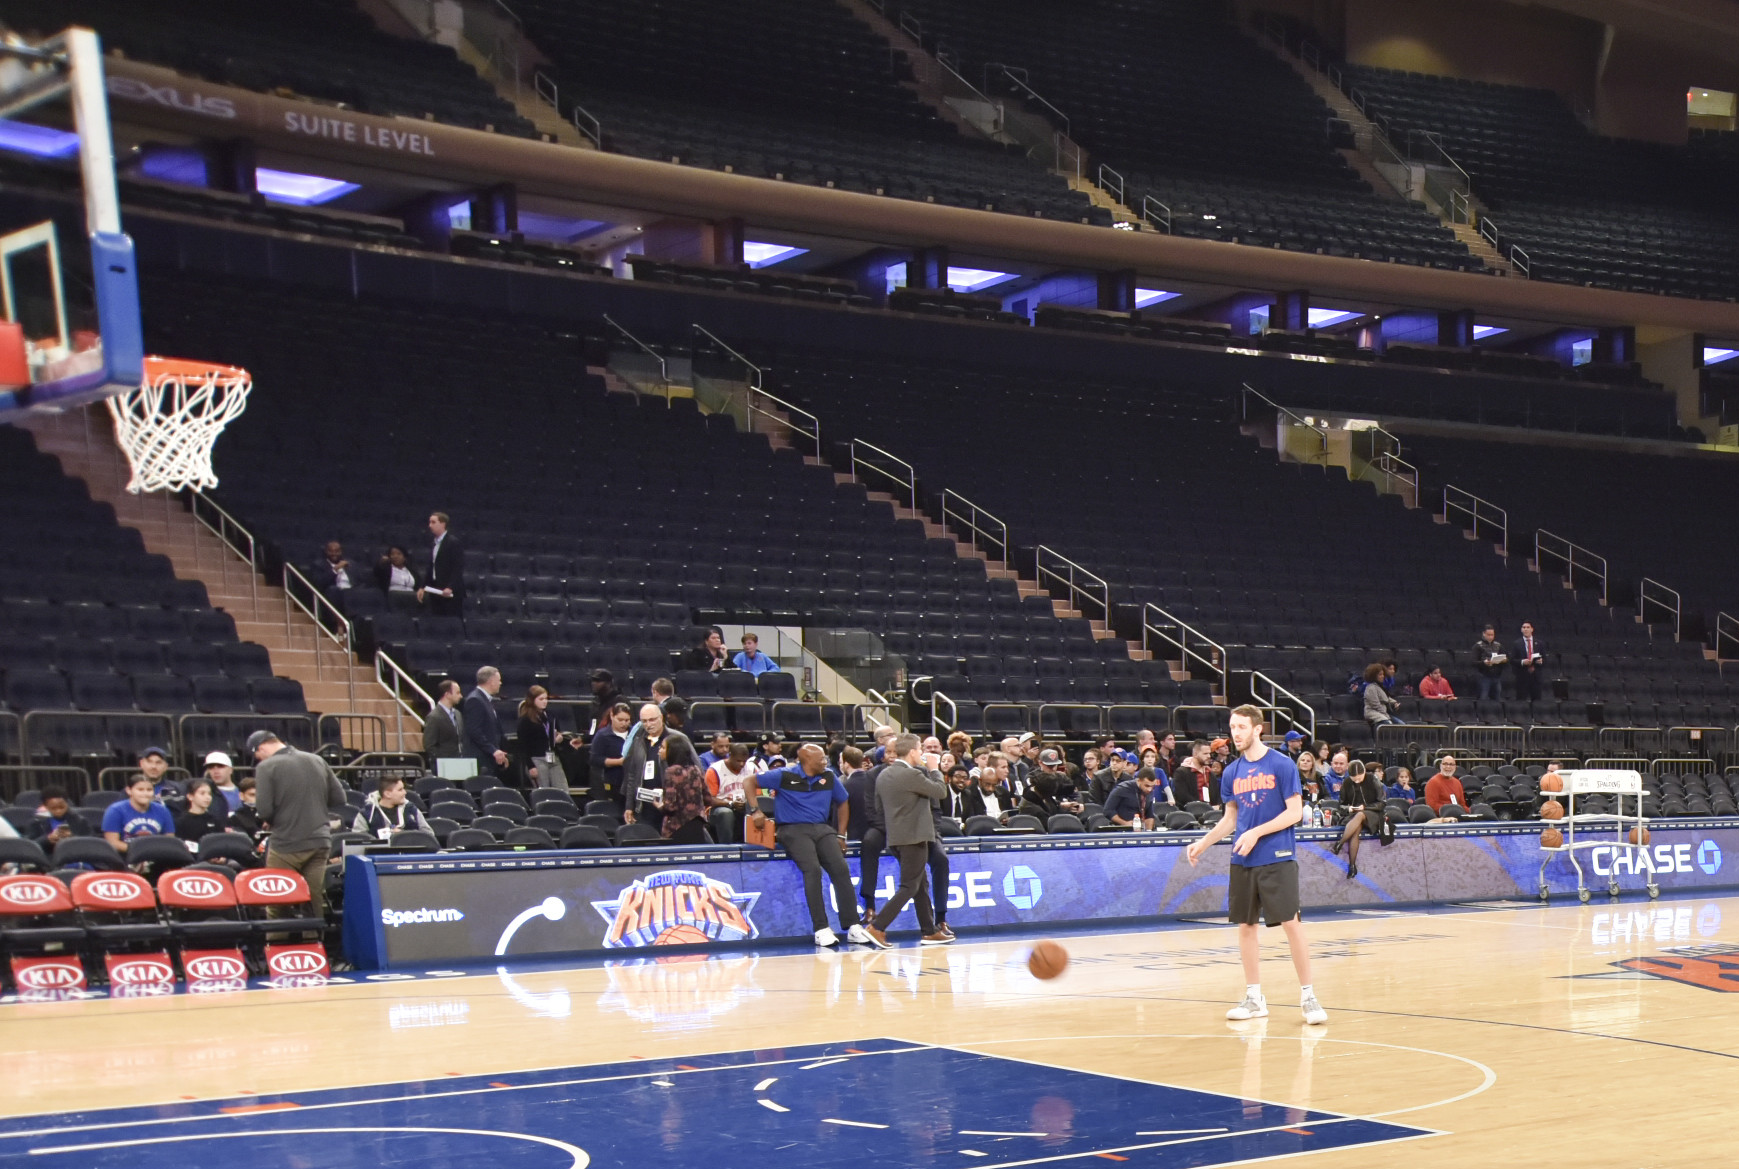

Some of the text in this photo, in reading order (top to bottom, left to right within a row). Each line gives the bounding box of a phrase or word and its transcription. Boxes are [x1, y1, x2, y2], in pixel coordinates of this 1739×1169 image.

[107, 76, 236, 119] EXUS
[284, 111, 435, 156] SUITE LEVEL
[1233, 772, 1275, 795] Knicks
[1592, 844, 1694, 876] CHASE
[9, 886, 47, 900] KIA
[97, 883, 133, 897] KIA
[181, 881, 215, 894] KIA
[256, 879, 287, 892] KIA
[381, 907, 458, 928] Spectrum
[609, 884, 750, 944] KNICKS
[196, 961, 237, 976] KIA
[279, 956, 318, 970] KIA
[28, 969, 74, 986] KIA
[121, 966, 164, 981] KIA
